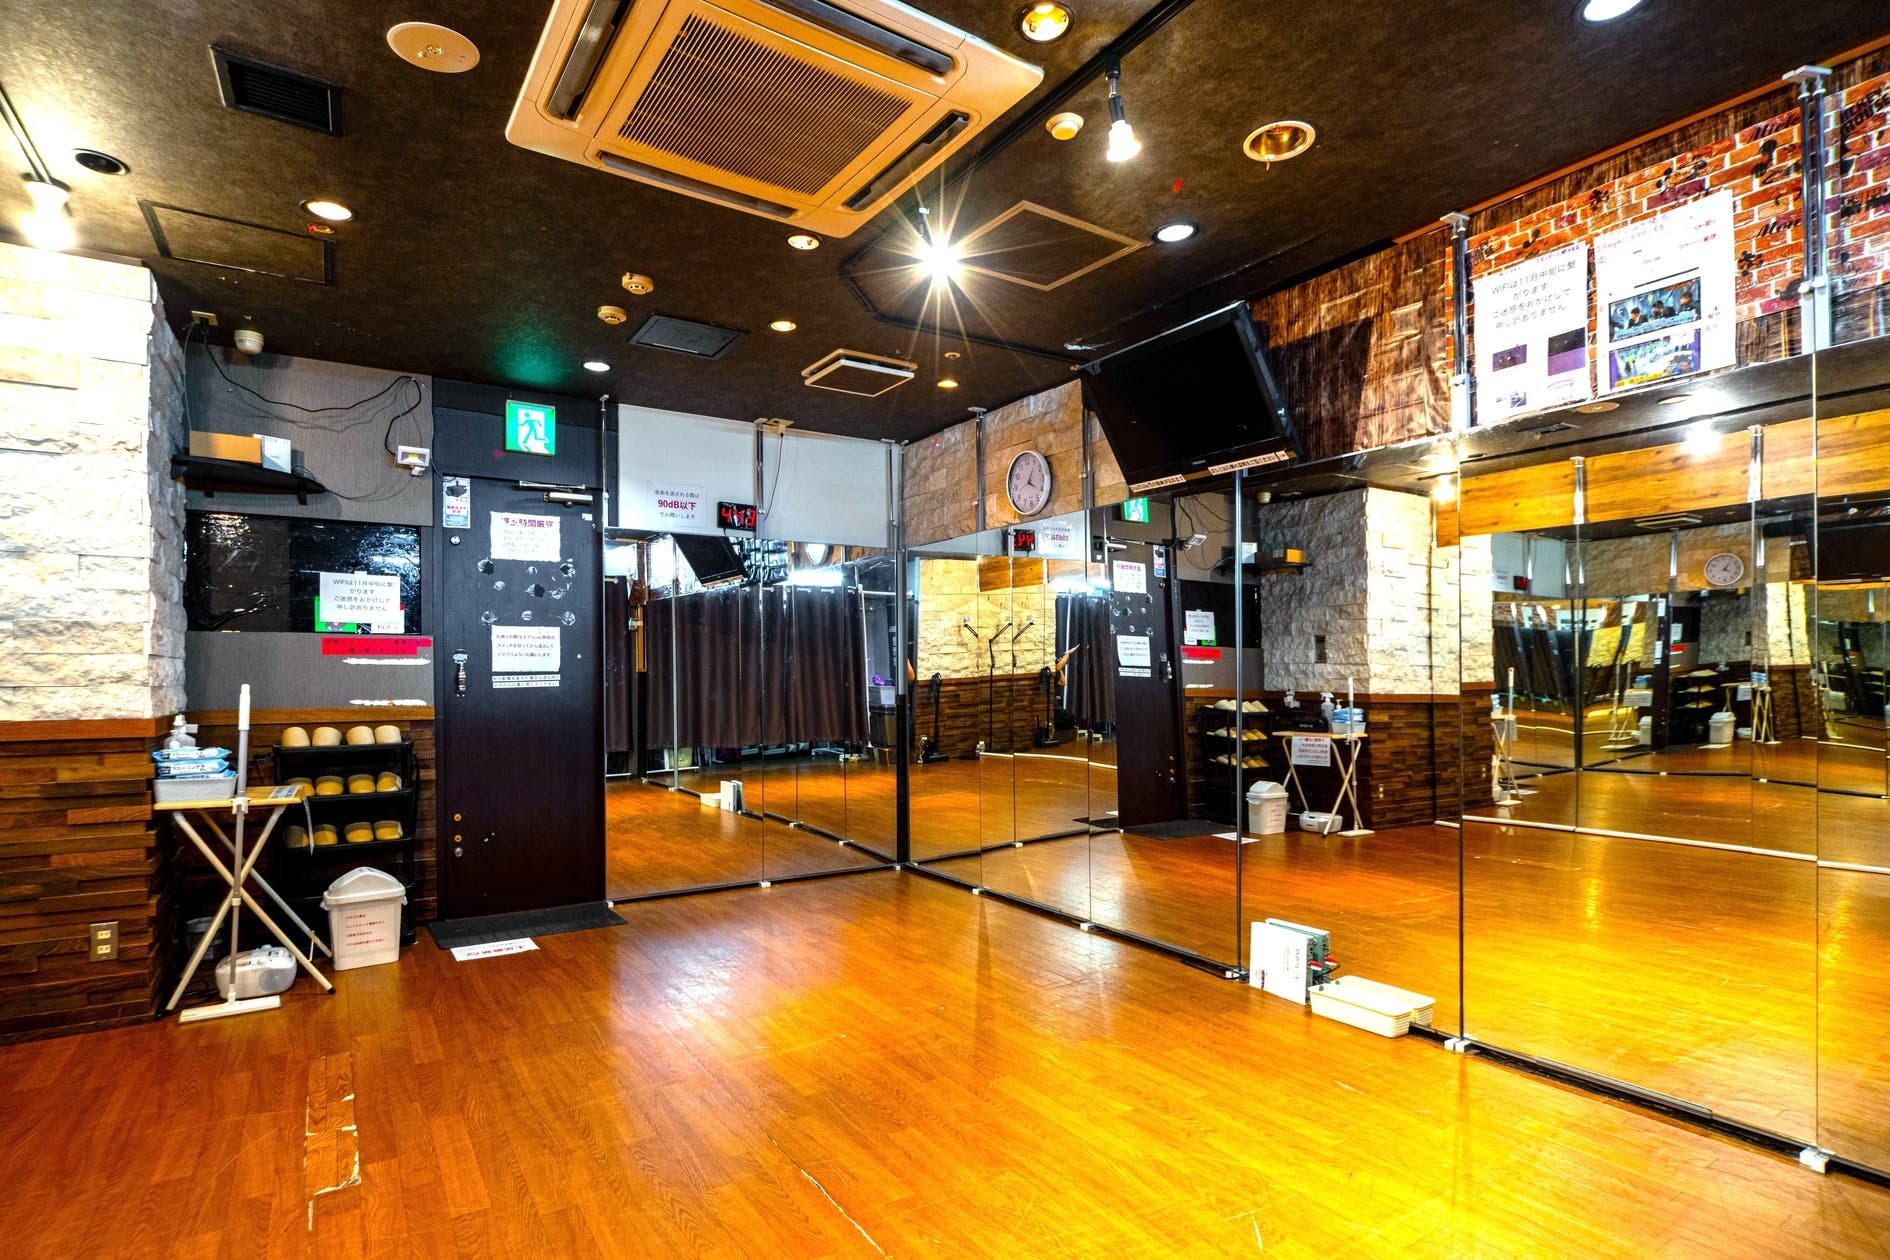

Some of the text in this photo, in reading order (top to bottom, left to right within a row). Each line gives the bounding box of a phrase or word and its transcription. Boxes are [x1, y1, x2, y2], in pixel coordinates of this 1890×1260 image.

[1513, 282, 1549, 301] がります
[1492, 288, 1571, 319] ご迷惑をおかけして
[658, 499, 697, 511] 90dB以下
[334, 595, 391, 603] ご迷惑をおかけして
